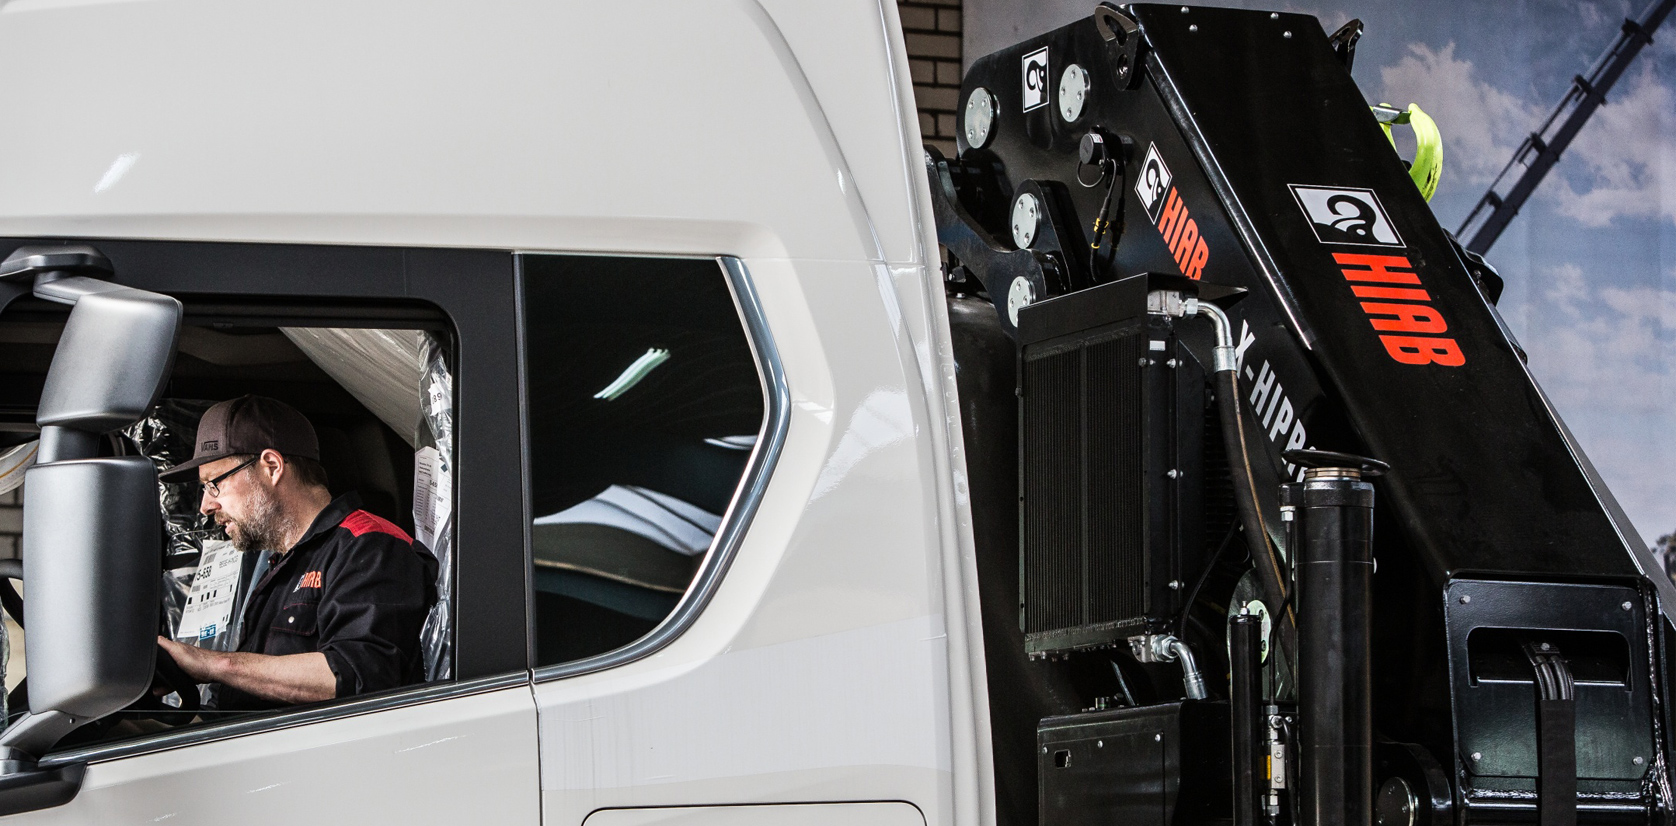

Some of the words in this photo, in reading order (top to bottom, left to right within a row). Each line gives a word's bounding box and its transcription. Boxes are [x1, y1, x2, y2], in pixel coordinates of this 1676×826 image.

[1158, 186, 1209, 281] HIAB
[1331, 252, 1466, 367] HIAB
[200, 440, 219, 453] VANS
[1235, 319, 1317, 482] X-HIPR
[300, 570, 322, 588] HIAB
